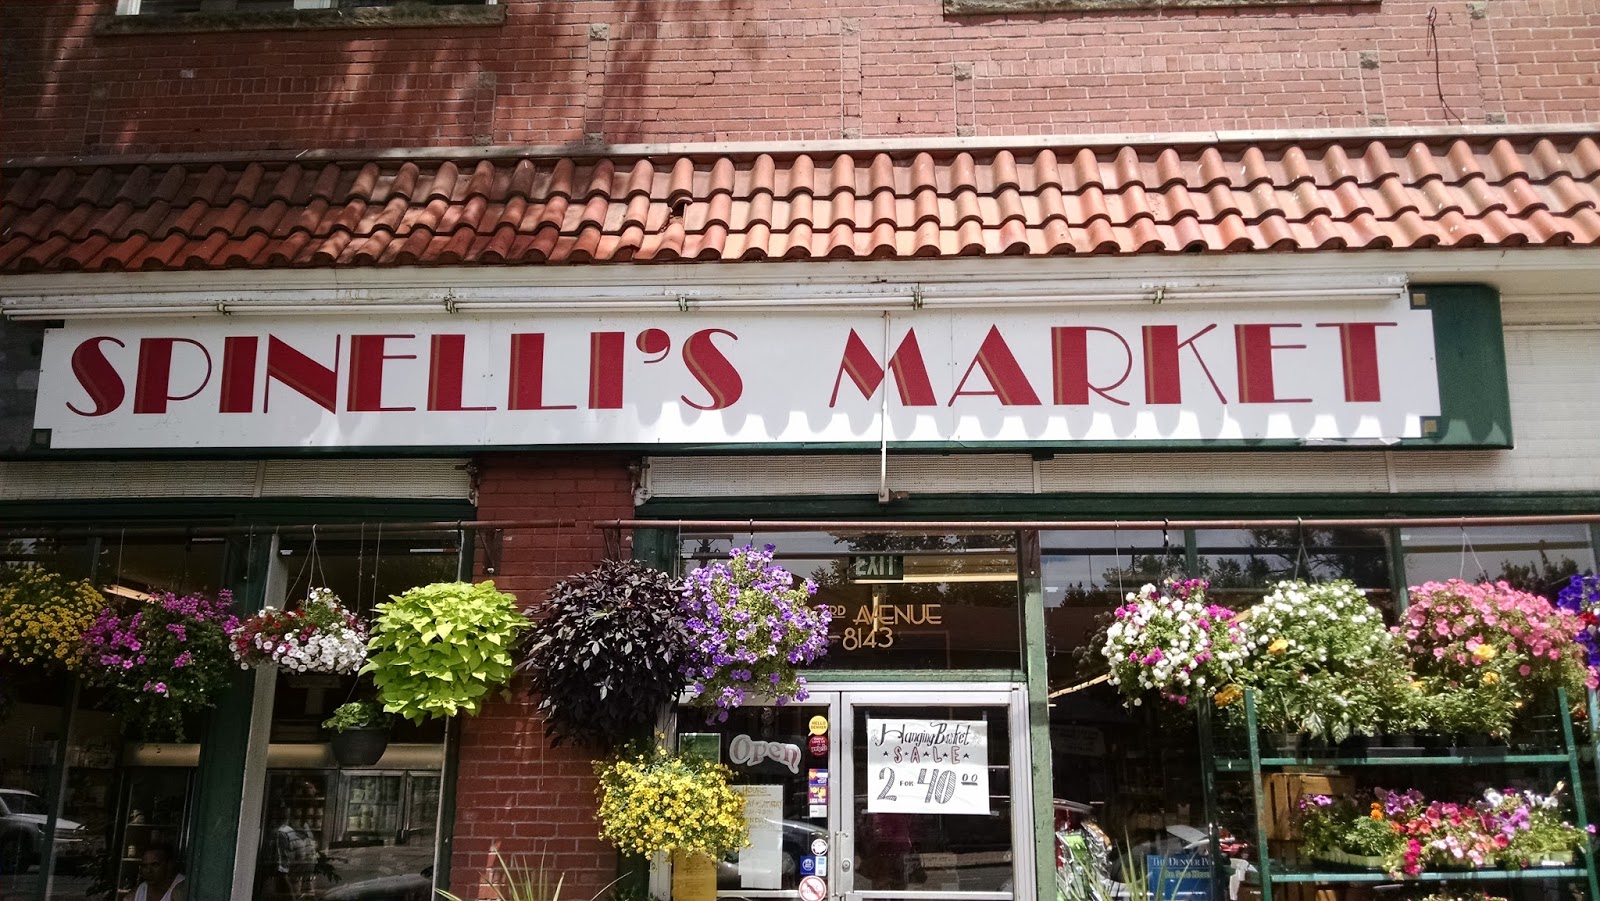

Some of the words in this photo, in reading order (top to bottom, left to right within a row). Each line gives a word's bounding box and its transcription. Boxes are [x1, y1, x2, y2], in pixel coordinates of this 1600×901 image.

[65, 328, 744, 417] SPINELLI'S
[829, 322, 1398, 408] MARKET
[853, 603, 942, 625] AVENUE
[930, 722, 971, 746] Basket
[732, 737, 799, 771] Open
[877, 767, 897, 802] 2
